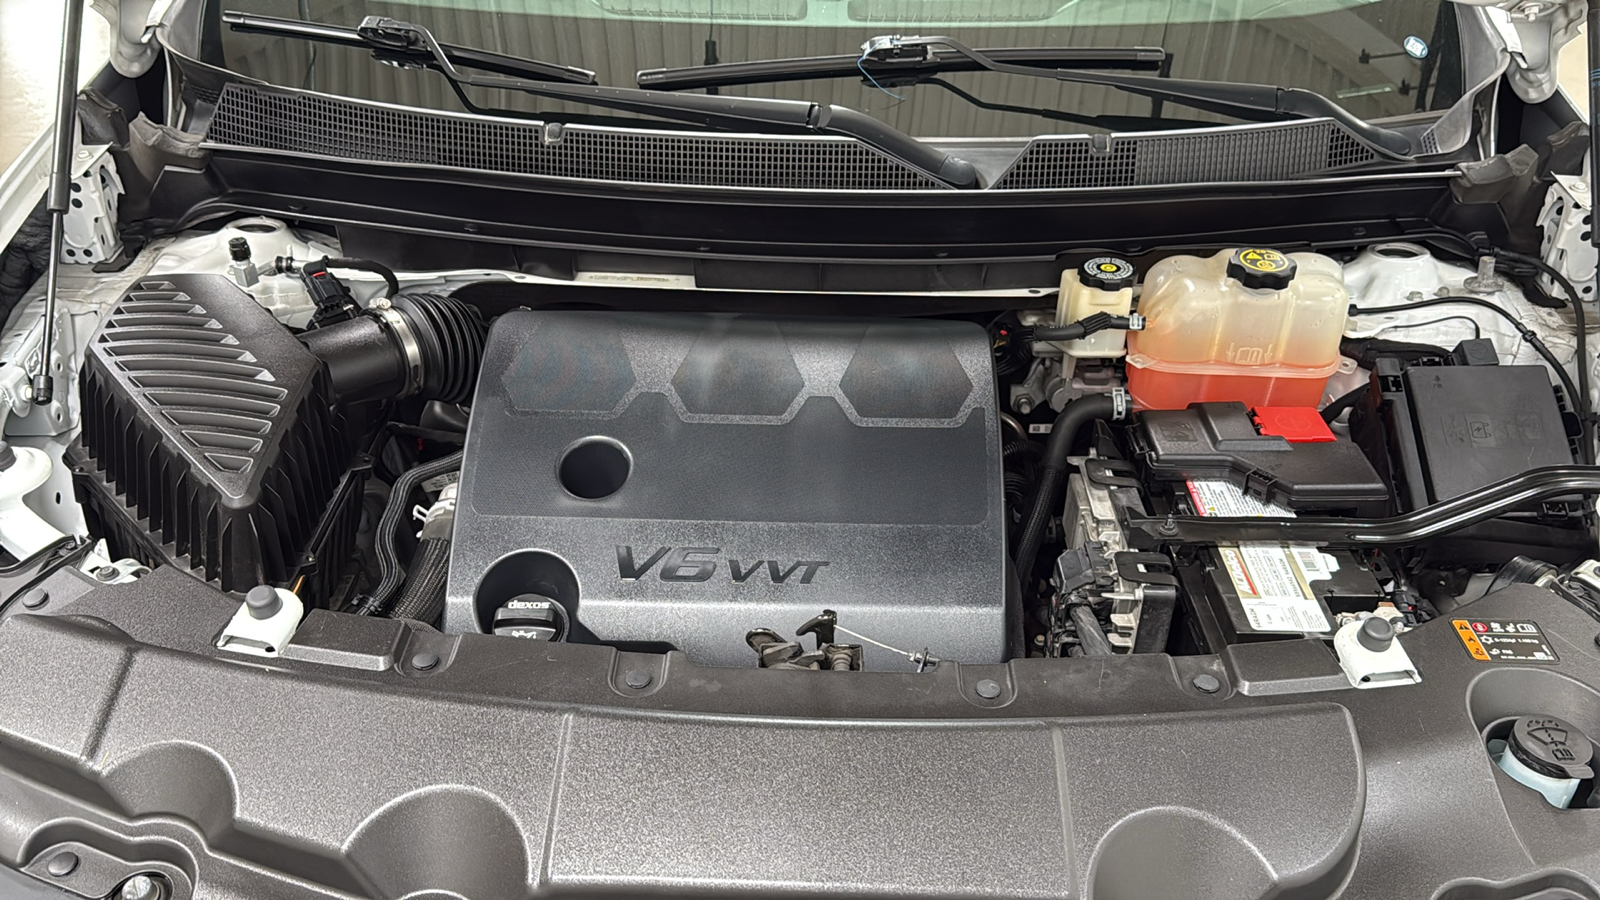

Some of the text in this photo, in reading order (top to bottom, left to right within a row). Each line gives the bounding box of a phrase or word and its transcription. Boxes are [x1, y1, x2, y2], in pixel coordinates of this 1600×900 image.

[615, 546, 830, 584] V6 VVT
[507, 599, 552, 609] dexos
